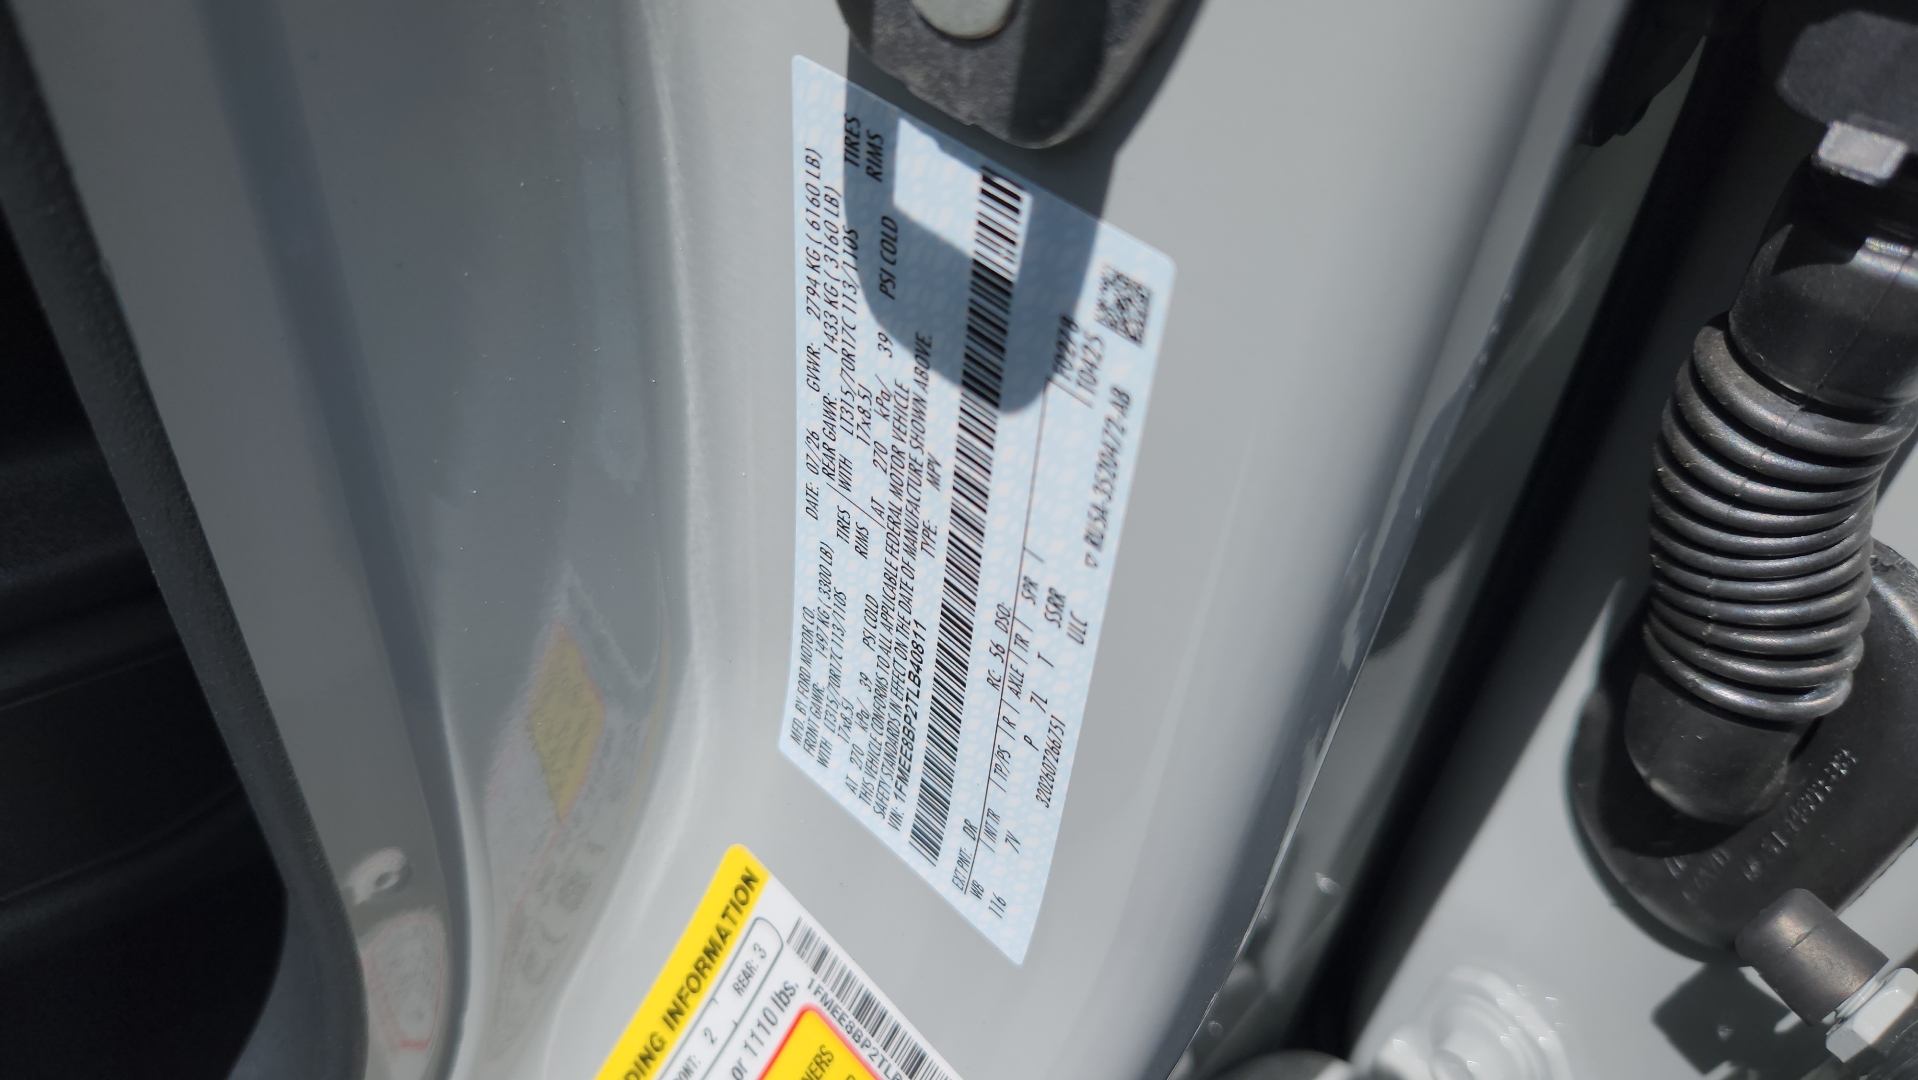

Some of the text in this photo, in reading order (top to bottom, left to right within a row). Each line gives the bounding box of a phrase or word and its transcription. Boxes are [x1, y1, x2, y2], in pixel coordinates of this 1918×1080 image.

[843, 112, 861, 168] TIRES
[865, 129, 884, 183] RIMS
[804, 147, 823, 180] LB)
[805, 182, 821, 232] 6160
[823, 185, 842, 218] LB)
[805, 246, 821, 274] KG
[823, 219, 839, 269] 3160
[805, 275, 821, 322] 2794
[823, 282, 839, 310] KG
[823, 310, 839, 355] 1433
[806, 342, 821, 393] GVWR:
[837, 224, 859, 493] WITH LT315/70R17C 113/110S
[870, 215, 898, 521] AT 270 kPa/ 39 PSI COLD
[821, 392, 837, 442] GAWR:
[856, 382, 873, 447] 17x8.5J
[804, 428, 822, 521] DATE: 07/26
[821, 441, 836, 482] REAR
[836, 505, 851, 545] TIRES
[920, 452, 942, 559] TYPE: MPV
[819, 540, 835, 567] LB)
[854, 521, 869, 560] RIMS
[818, 563, 832, 601] 3300
[858, 378, 910, 806] THIS VEHICLE CONFORMS TO ALL APPLICABLE FEDERAL MOTOR VEHICLE
[872, 333, 932, 820] SAFETY STANDARDS IN EFFECT ON THE DATE OF MANUFACTURE SHOWN ABOVE.
[1021, 575, 1039, 606] SPR
[816, 606, 830, 629] KG
[1044, 587, 1066, 629] SSRR
[1067, 610, 1088, 645] ULC
[815, 624, 829, 659] 1497
[988, 639, 1006, 664] 56
[1013, 632, 1030, 653] TR
[1037, 651, 1054, 668] T
[789, 605, 816, 746] MFD. BY FORD MOTOR CO.
[816, 586, 847, 769] WITH LT315/70R17C 113/110S
[844, 593, 879, 796] AT 270 kPa/ 39 PSI COLD
[986, 668, 1002, 692] RC:
[1007, 663, 1025, 700] AXLE
[809, 682, 826, 720] GAWR:
[837, 696, 855, 744] 17x8.5J
[1029, 690, 1048, 714] 7L
[802, 716, 820, 758] FRONT
[887, 618, 927, 832] VIN: 1FMEE8BP2TLB40811
[1002, 715, 1017, 730] R
[1023, 734, 1039, 752] P
[993, 744, 1012, 782] TP/PS
[1035, 714, 1066, 809] 3202607266751
[983, 807, 1001, 844] INT TR
[1004, 829, 1021, 854] 7V
[951, 818, 978, 892] EXT PNT: DR
[969, 879, 985, 900] WB
[988, 891, 1007, 919] 116
[662, 864, 761, 1033] INFORMATION
[732, 941, 768, 998] REAR: 3
[704, 1026, 719, 1046] 2
[731, 979, 800, 1080] or 1110 lbs.
